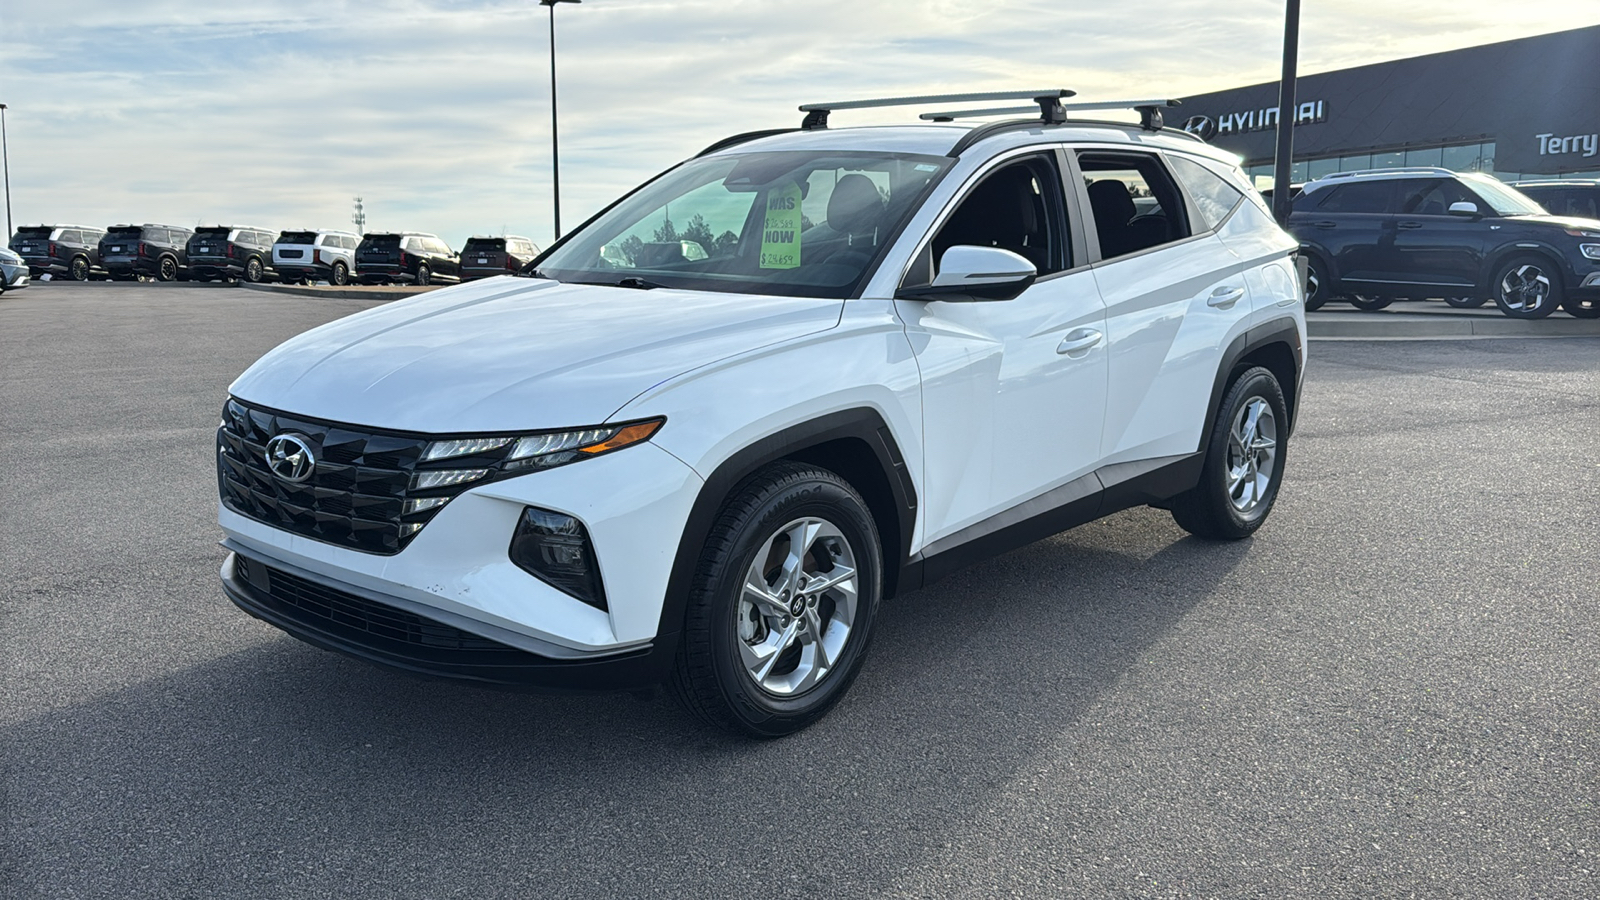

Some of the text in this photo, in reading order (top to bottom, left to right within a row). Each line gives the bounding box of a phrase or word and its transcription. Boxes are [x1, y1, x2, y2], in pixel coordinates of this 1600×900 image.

[1218, 100, 1323, 132] HYUNAI
[1535, 133, 1598, 157] Terry
[769, 197, 795, 210] WAS
[764, 230, 795, 243] NOW
[758, 489, 811, 524] KUMHO
